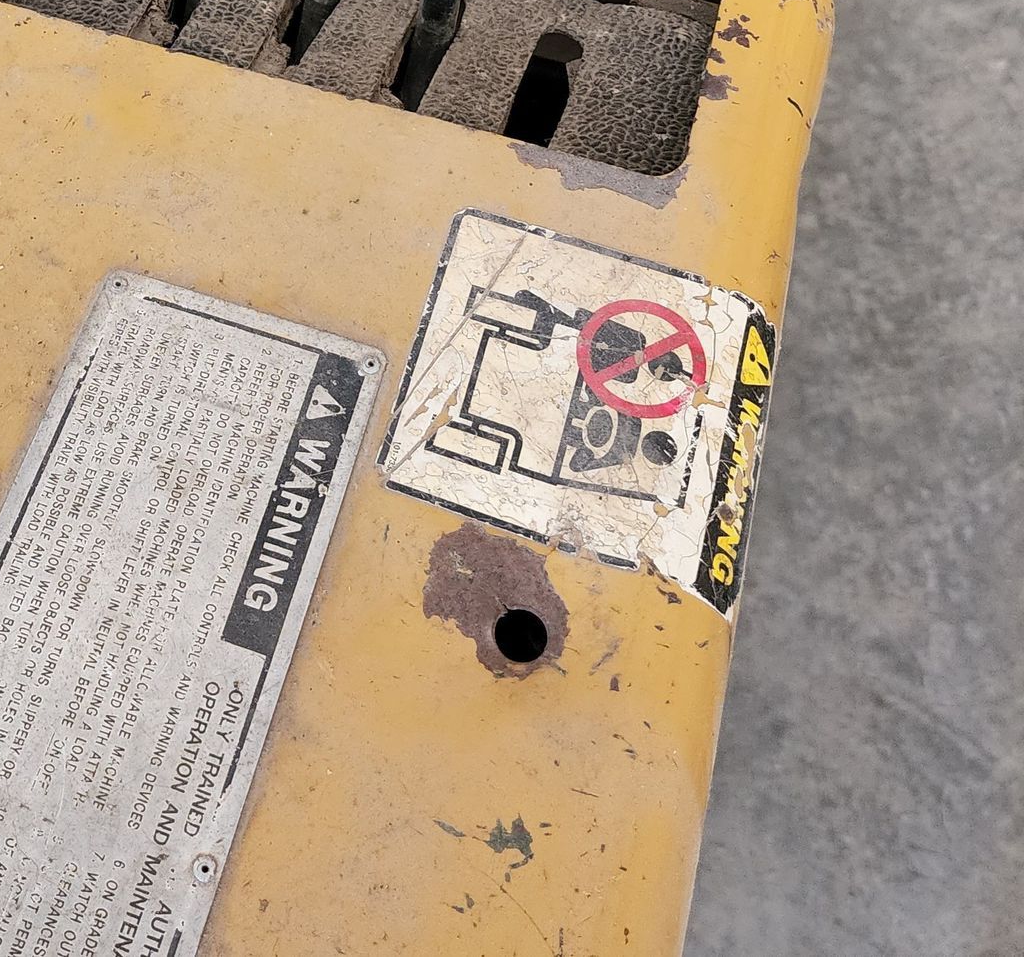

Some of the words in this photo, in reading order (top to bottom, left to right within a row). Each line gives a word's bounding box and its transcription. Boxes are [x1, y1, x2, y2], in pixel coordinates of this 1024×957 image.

[117, 322, 140, 358] TRAVEL
[147, 331, 172, 370] UNEVEN
[95, 349, 114, 373] WITH
[105, 361, 124, 386] WITH
[179, 341, 203, 381] SWITCH
[245, 361, 267, 397] REFER
[267, 366, 283, 388] FOR
[91, 390, 111, 418] LOAD
[123, 373, 155, 430] SURFACES.
[152, 373, 173, 402] TURN
[174, 383, 187, 395] IS
[276, 372, 300, 414] BEFORE
[83, 421, 98, 436] AS
[101, 380, 134, 438] SURFACES.
[142, 404, 160, 428] AND
[155, 398, 181, 441] TURNED
[215, 412, 230, 429] DO
[250, 392, 274, 435] PROPER
[53, 430, 78, 469] TRAVEL
[71, 439, 90, 464] LOW
[90, 441, 108, 464] USE
[108, 432, 130, 465] AVOID
[126, 430, 149, 466] BRAKE
[183, 408, 213, 465] PARTIALLY
[205, 432, 222, 455] NOT
[217, 421, 245, 474] MACHINE
[256, 416, 284, 469] STARTING
[40, 471, 60, 498] WITH
[63, 467, 78, 483] AS
[153, 441, 182, 494] CONTROL
[66, 467, 97, 520] EXTREME
[85, 469, 115, 519] RUNNING
[144, 497, 160, 515] OR
[164, 469, 190, 513] LOADED
[181, 458, 213, 519] OVERLOAD.
[26, 502, 47, 531] LOAD
[38, 486, 70, 540] POSSIBLE
[179, 478, 223, 574] IDENTIFICATION
[242, 433, 330, 614] WARNING
[43, 523, 73, 575] CAUTION
[71, 522, 93, 554] OVER
[129, 518, 152, 552] SHIFT
[139, 517, 171, 578] MACHINES
[159, 523, 188, 576] OPERATE
[219, 531, 243, 571] CHECK
[1, 535, 33, 588] TRAILING.
[26, 543, 45, 569] AND
[113, 556, 137, 594] LEVER
[7, 572, 33, 613] TILTED
[26, 579, 50, 615] WHEN
[53, 557, 78, 597] LOOSE
[66, 574, 91, 611] DOWN
[209, 575, 227, 599] ALL
[106, 598, 120, 611] IN
[134, 580, 166, 642] MACHINES
[29, 600, 61, 654] OBJECTS
[54, 615, 74, 640] FOR
[82, 616, 113, 673] NEUTRAL
[112, 622, 131, 648] NOT
[184, 602, 217, 669] CONTROLS
[19, 658, 37, 678] OR
[34, 644, 62, 690] TURNS,
[85, 652, 119, 717] HANDLING
[109, 646, 141, 709] EQUIPPED
[173, 672, 192, 700] AND
[0, 681, 27, 724] HOLES
[60, 676, 89, 728] BEFORE
[213, 687, 245, 742] ONLY
[8, 693, 42, 755] SLIPPERY
[94, 712, 116, 746] WITH
[149, 705, 181, 767] WARNING
[169, 679, 221, 793] OPERATION
[71, 750, 102, 809] ATTAH-
[91, 744, 125, 811] MACHINE
[181, 748, 224, 838] TRAINED
[126, 771, 157, 831] DEVICES
[151, 799, 180, 847] AND
[69, 870, 98, 924] WATCH
[100, 878, 119, 902] ON
[55, 928, 77, 957] OUT
